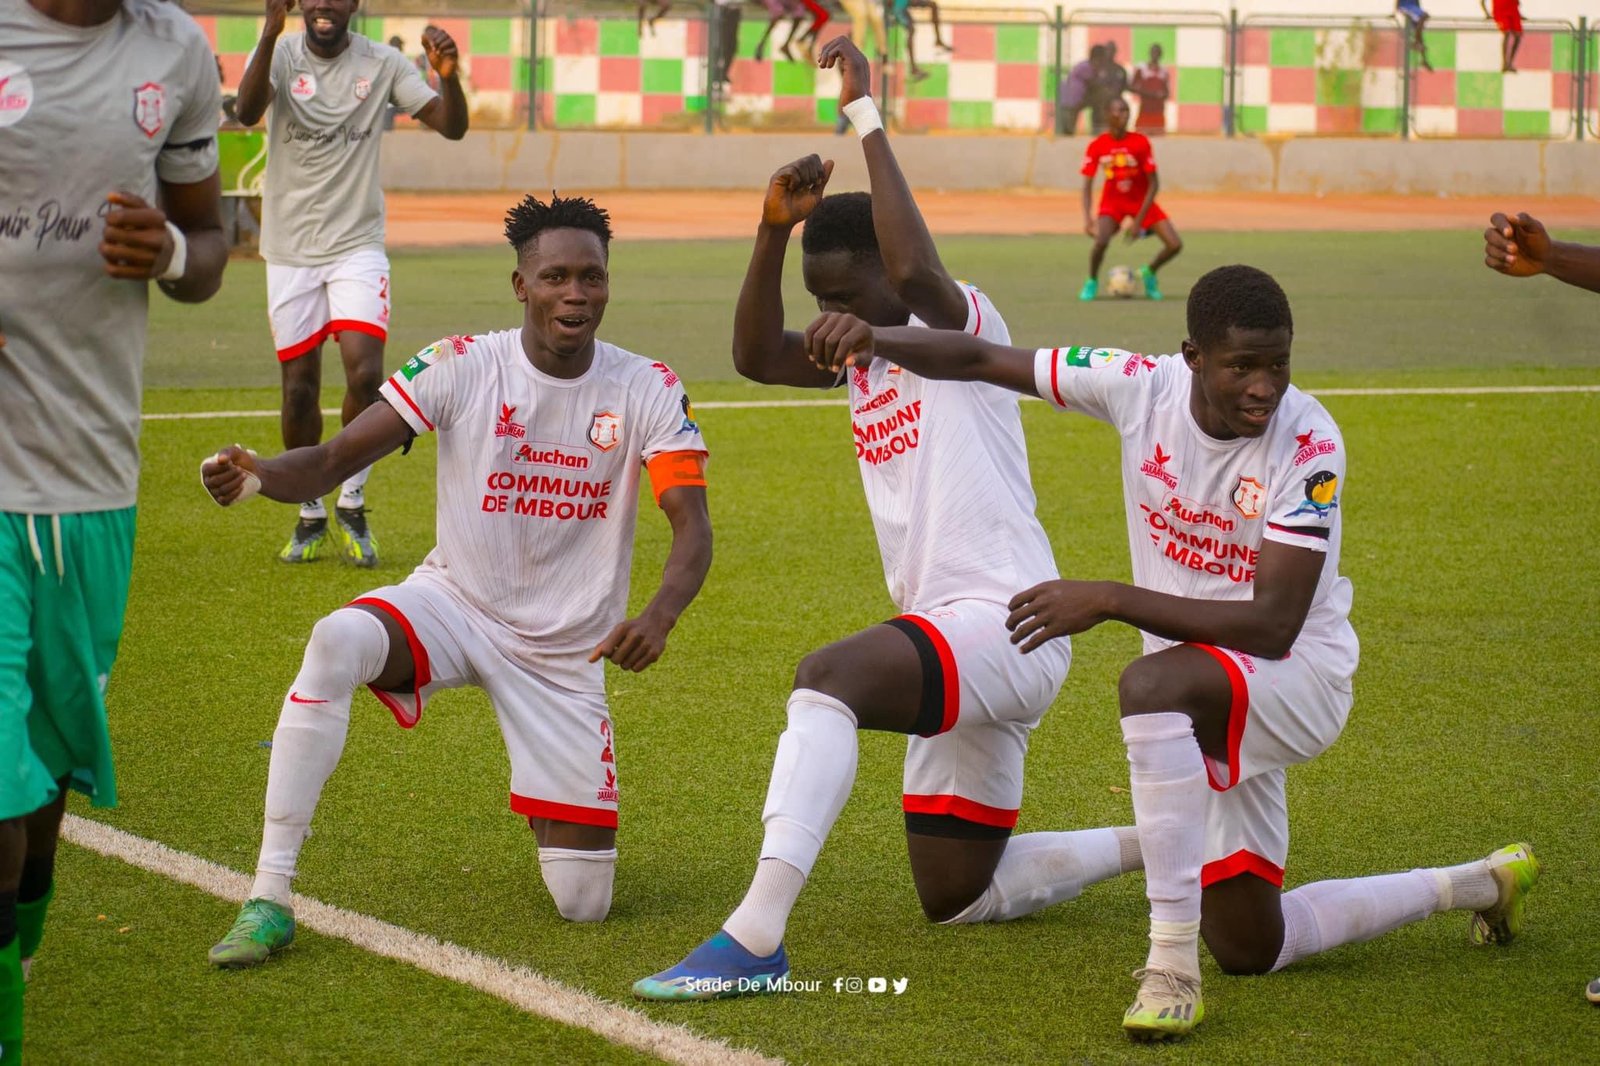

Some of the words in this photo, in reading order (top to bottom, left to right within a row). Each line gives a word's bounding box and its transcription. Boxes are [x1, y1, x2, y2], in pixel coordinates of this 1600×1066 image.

[36, 199, 92, 252] Pour
[514, 444, 588, 469] Auchan
[487, 471, 612, 499] COMMUNE
[481, 494, 509, 513] DE
[514, 497, 608, 521] MBOUR
[1164, 497, 1234, 532] Auchan
[600, 720, 614, 763] 2
